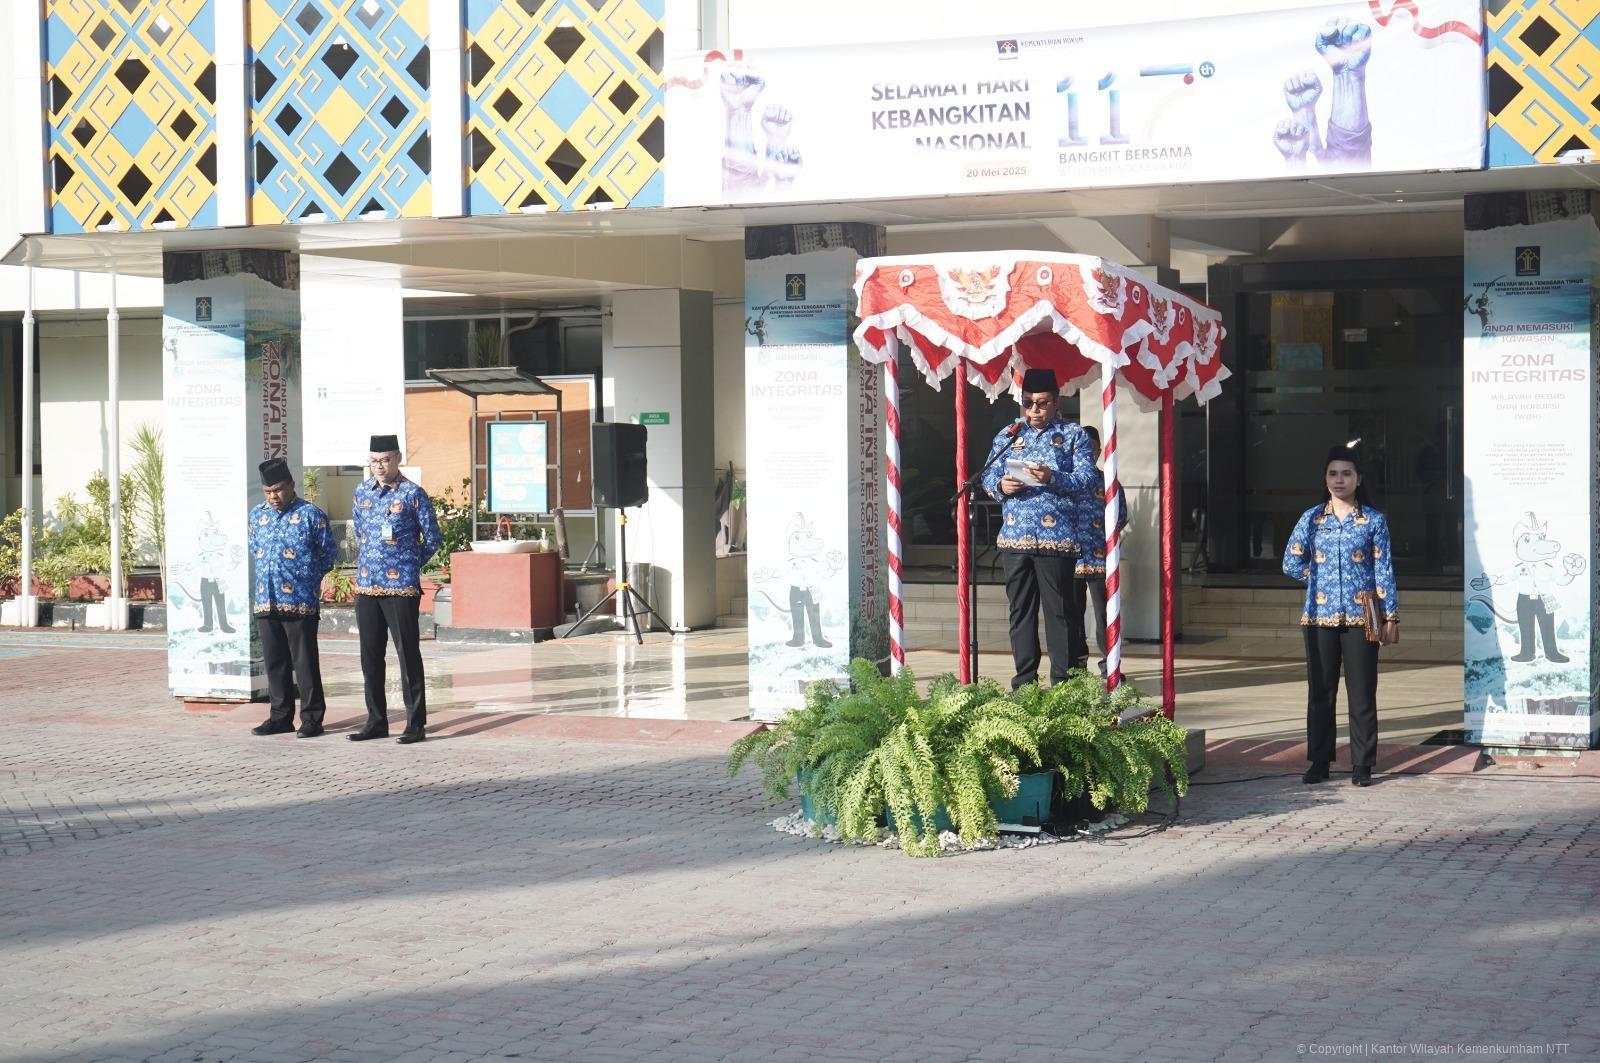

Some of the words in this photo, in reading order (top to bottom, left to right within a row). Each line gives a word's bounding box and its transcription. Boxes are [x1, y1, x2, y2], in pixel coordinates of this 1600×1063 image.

[871, 80, 967, 102] SELAMAT
[978, 78, 1030, 95] HARI
[871, 101, 1031, 130] KEBANGKITAN
[915, 131, 1031, 151] NASIONAL
[1059, 150, 1120, 164] BANGKIT
[1125, 146, 1192, 160] BERSAMA
[966, 169, 979, 178] 20
[982, 167, 1000, 178] Mei
[1003, 166, 1027, 177] 2025
[1484, 323, 1514, 332] ANDA
[1516, 322, 1573, 332] MEMASUKI
[1502, 335, 1555, 343] KAWASAN
[1501, 354, 1555, 367] ZONA
[269, 341, 281, 424] ZONA
[775, 370, 818, 382] ZONA
[1471, 369, 1586, 383] INTEGRITAS
[186, 384, 222, 394] ZONA
[751, 384, 843, 397] INTEGRITAS
[167, 396, 242, 408] INTEGRITAS
[865, 427, 874, 621] INTEGRITAS
